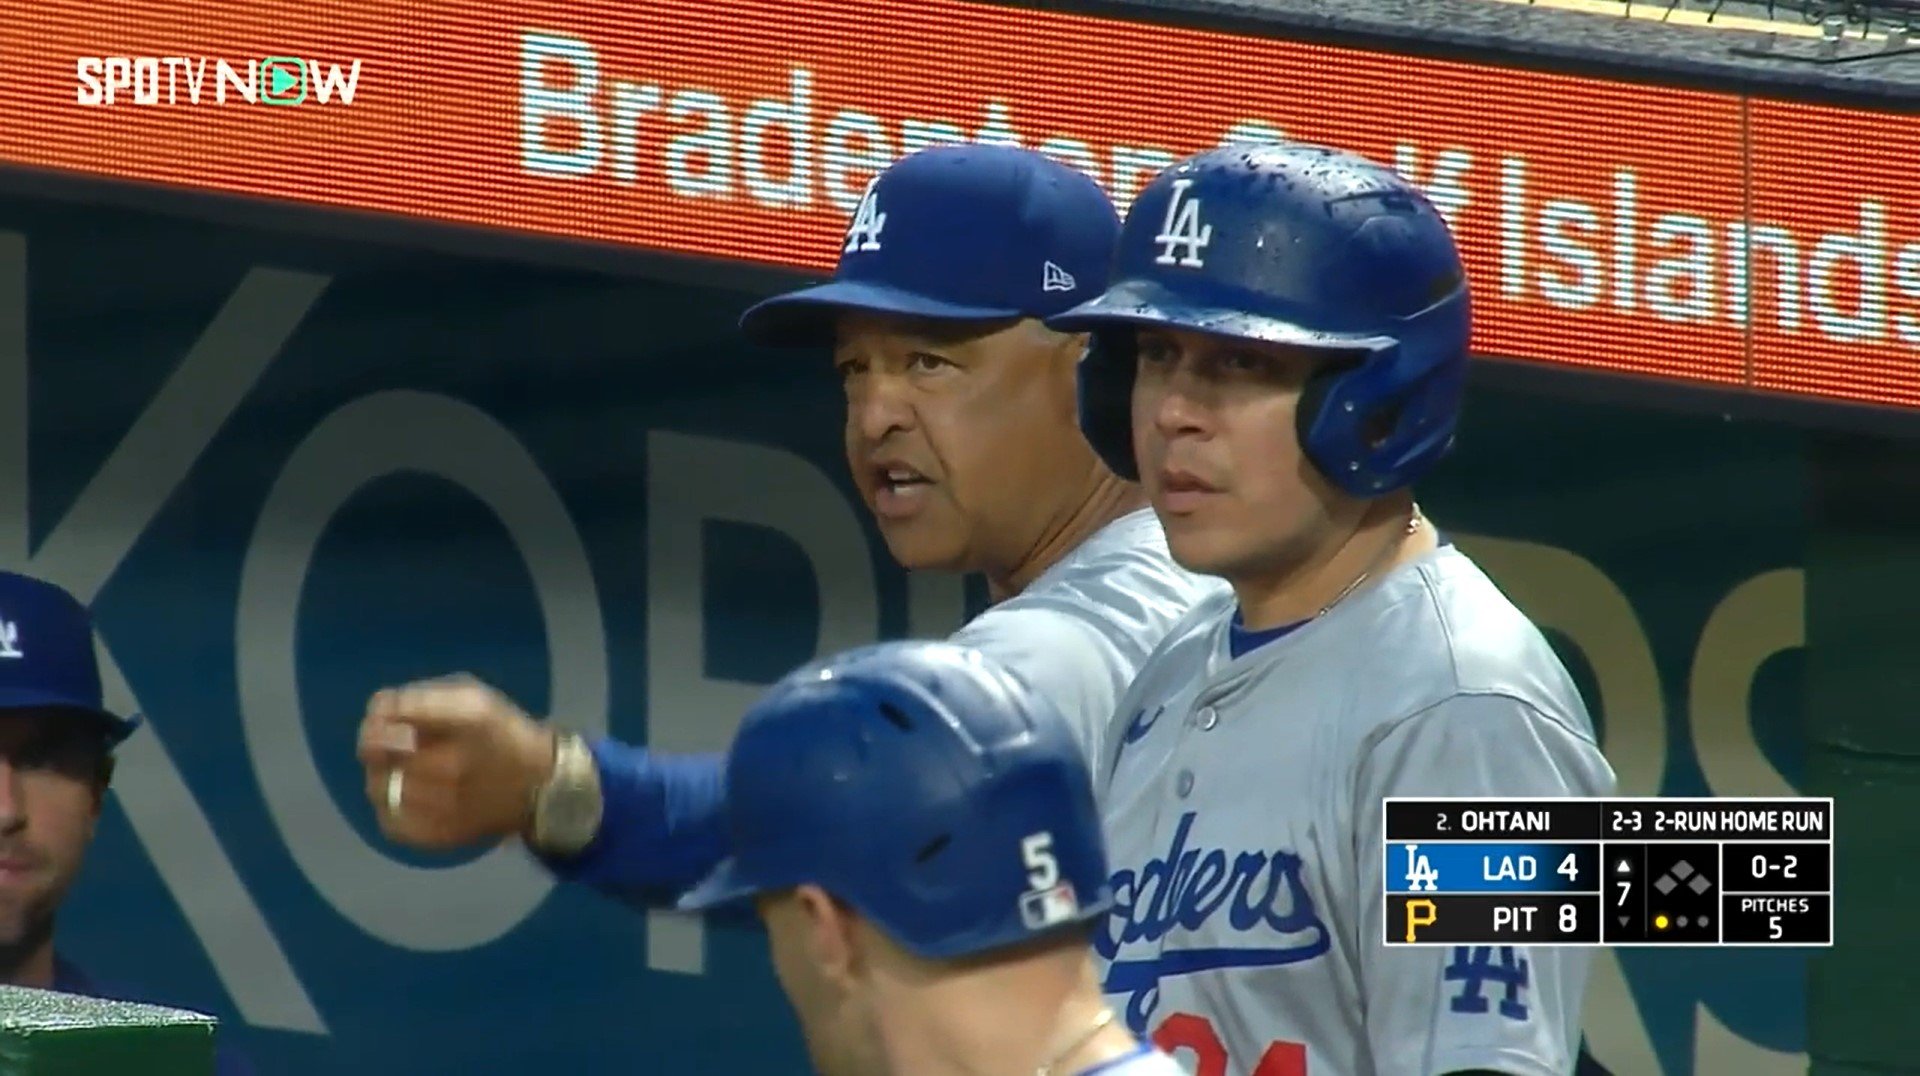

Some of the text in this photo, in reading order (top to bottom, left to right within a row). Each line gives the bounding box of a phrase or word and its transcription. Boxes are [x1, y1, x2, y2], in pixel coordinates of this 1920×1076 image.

[1155, 178, 1212, 268] LA
[1020, 832, 1060, 892] 5
[1094, 811, 1331, 1040] odgers
